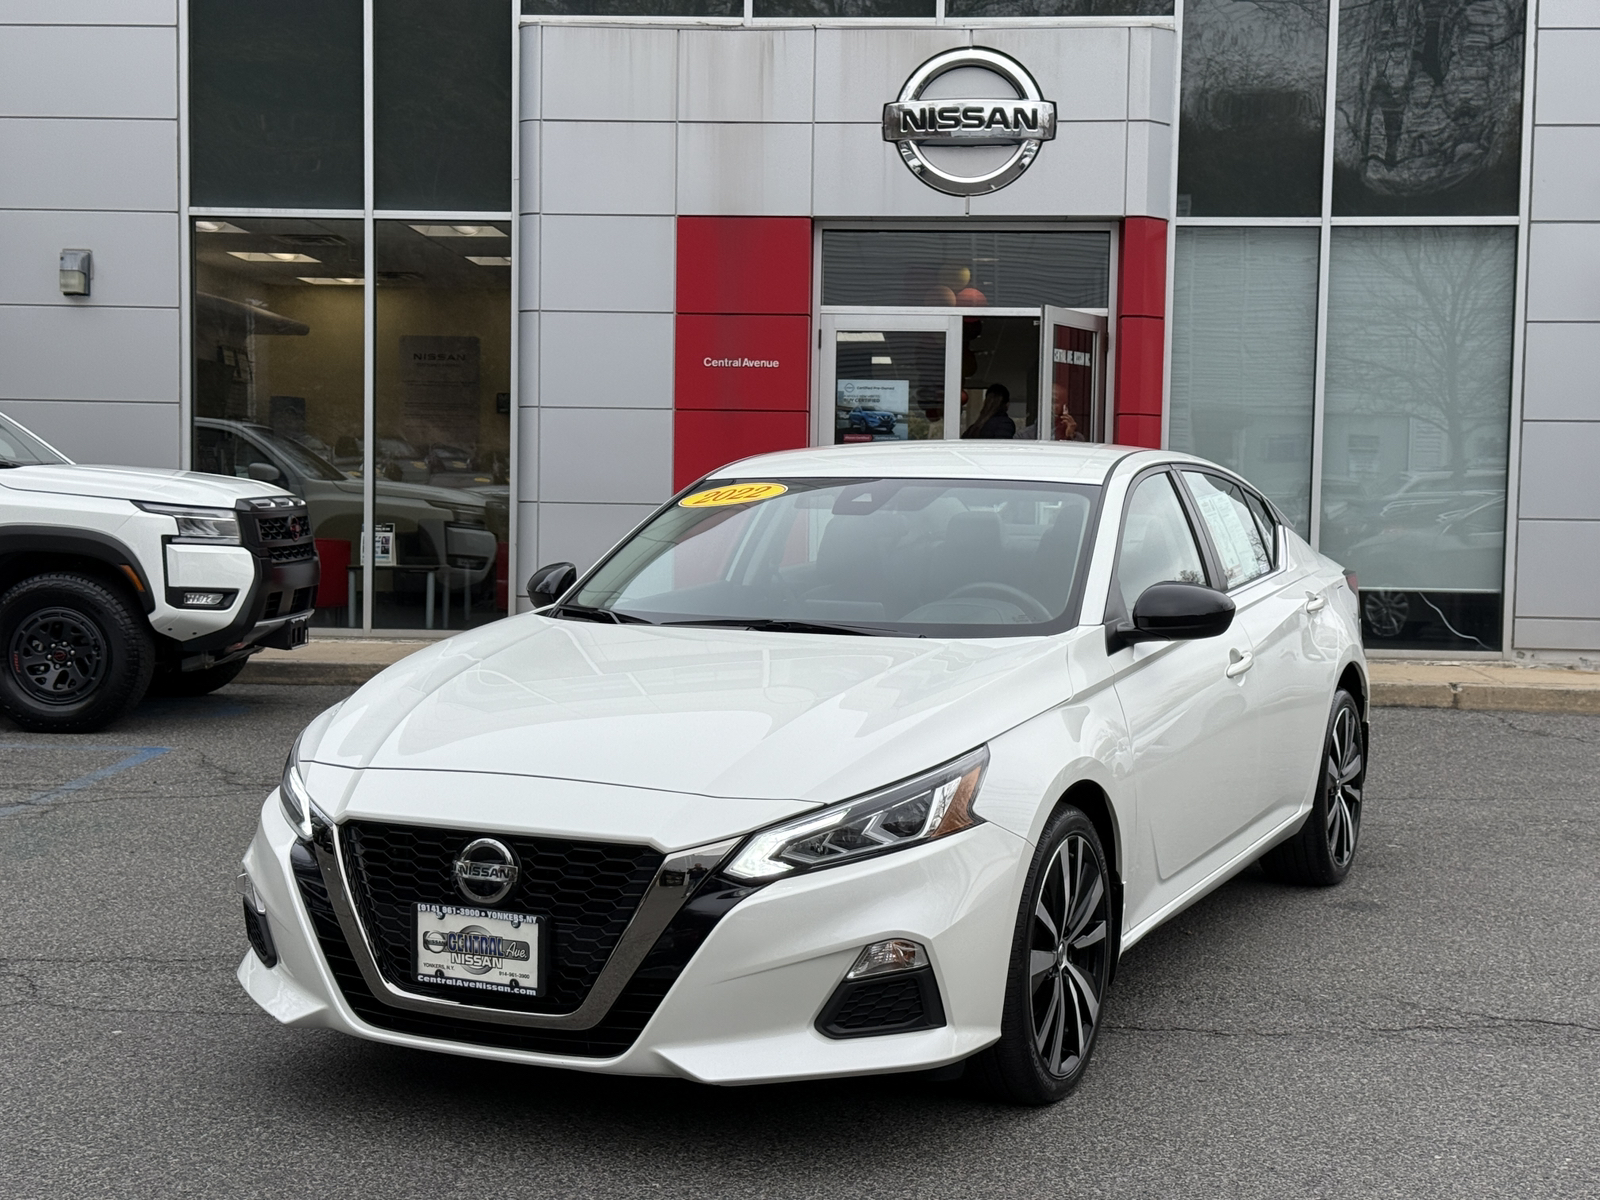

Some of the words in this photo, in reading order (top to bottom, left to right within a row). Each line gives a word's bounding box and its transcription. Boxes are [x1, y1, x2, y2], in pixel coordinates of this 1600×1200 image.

[900, 106, 1039, 132] NISSAN
[413, 353, 466, 361] NISSAN
[703, 357, 742, 367] Central
[742, 358, 780, 368] Avenue
[693, 486, 773, 505] 2022
[458, 866, 510, 879] NISSAN
[417, 903, 440, 913] (914)
[442, 906, 480, 917] 961-3900
[448, 931, 504, 957] CENTRAL
[506, 941, 528, 959] Ave.
[451, 952, 503, 969] NISSAN
[417, 975, 537, 996] CentralAveNissan.com
